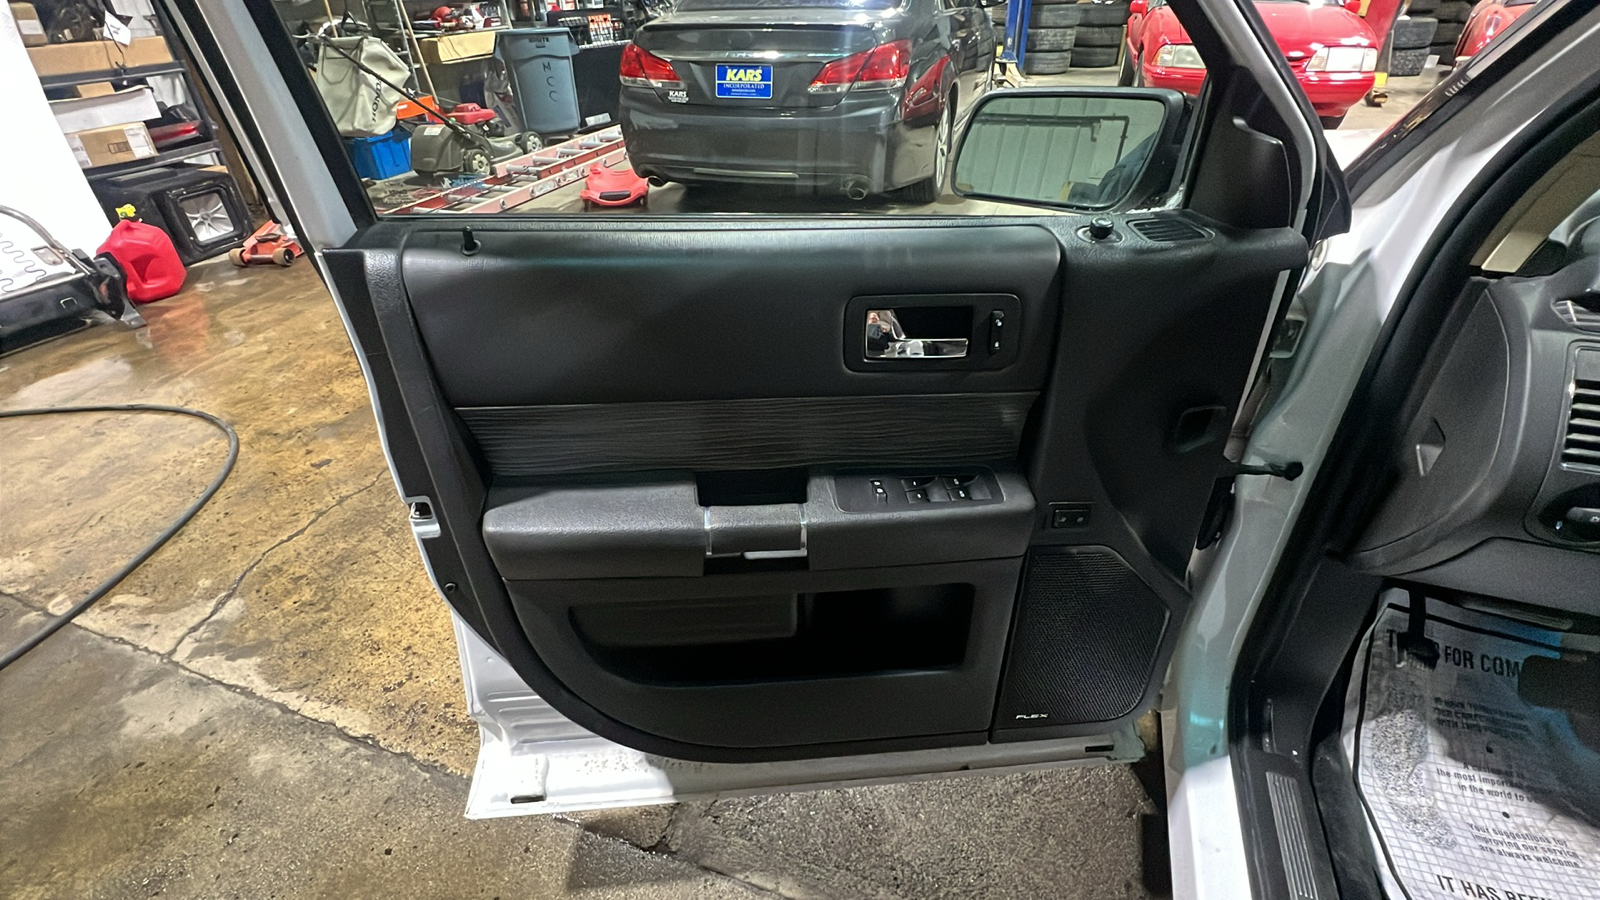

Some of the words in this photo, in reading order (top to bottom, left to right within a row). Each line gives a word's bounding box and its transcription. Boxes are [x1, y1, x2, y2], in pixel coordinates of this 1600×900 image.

[725, 68, 763, 82] KARS
[668, 90, 687, 98] KARS
[1444, 645, 1475, 670] FOR
[1480, 654, 1522, 678] COM
[1436, 767, 1451, 778] the
[1453, 772, 1477, 783] most
[1469, 785, 1484, 795] the
[1486, 789, 1512, 800] world
[1514, 792, 1525, 802] to
[1467, 822, 1490, 834] Your
[1492, 829, 1551, 844] suggestions
[1551, 837, 1568, 848] for
[1521, 843, 1538, 852] our
[1479, 844, 1496, 854] are
[1496, 848, 1533, 862] always
[1533, 855, 1581, 869] welcome
[1437, 874, 1455, 893] IT
[1460, 879, 1501, 900] HAS
